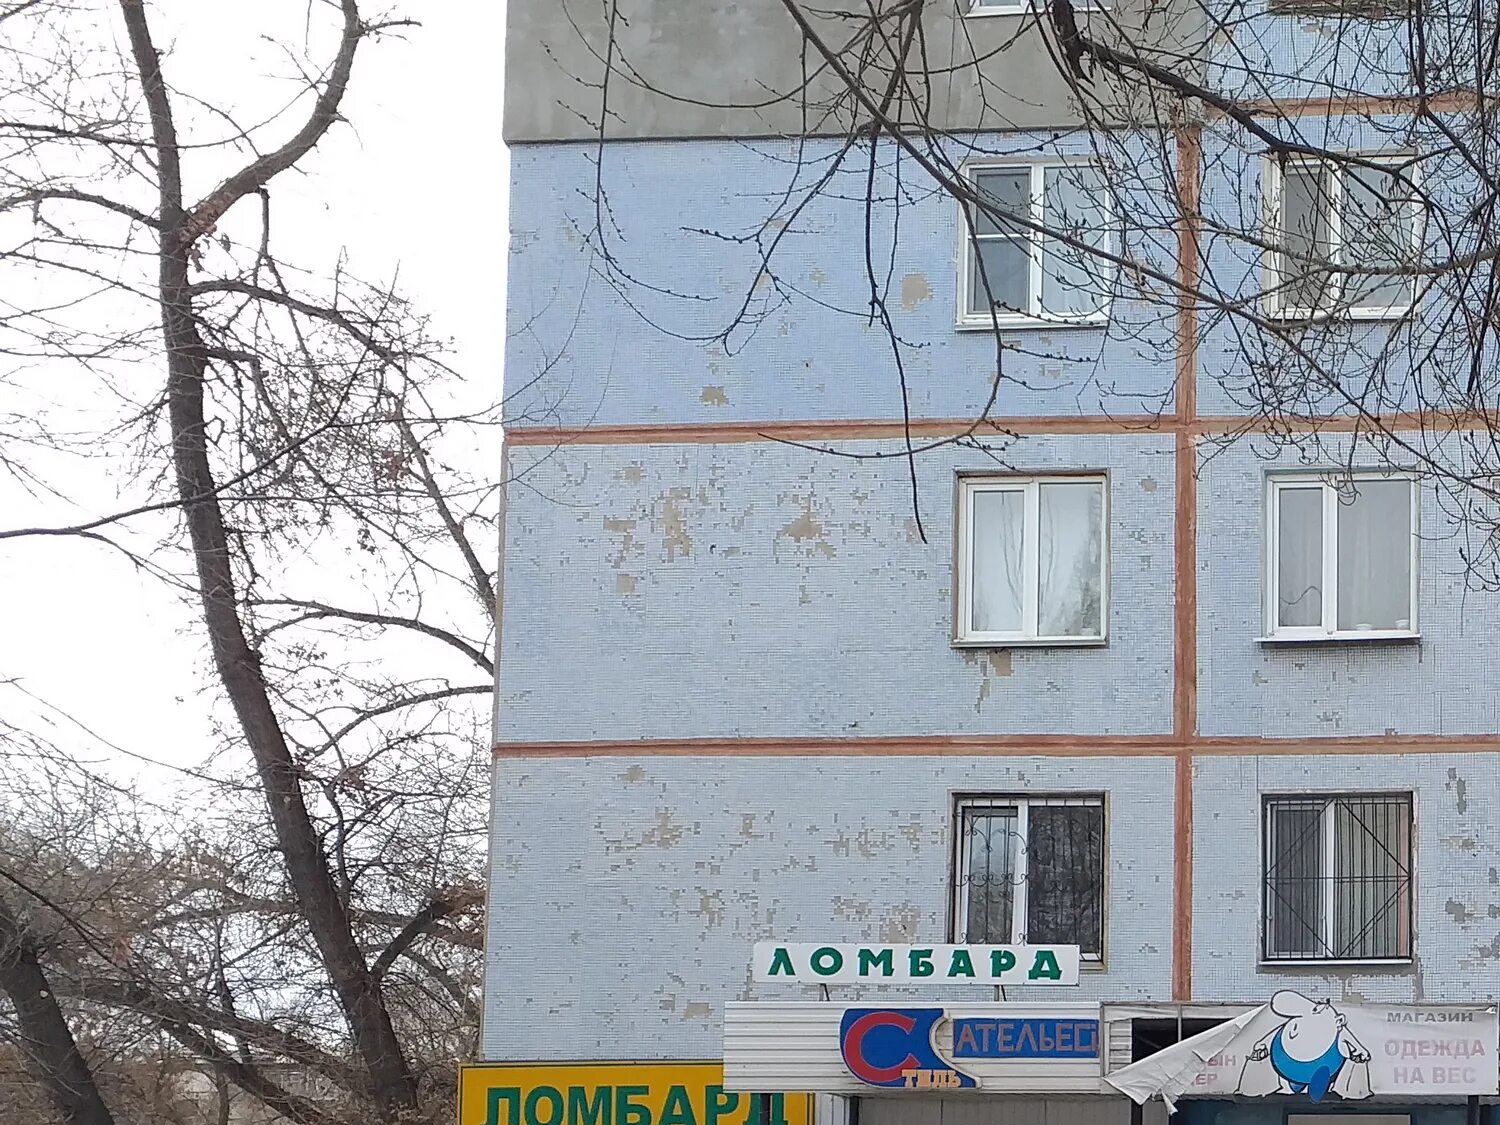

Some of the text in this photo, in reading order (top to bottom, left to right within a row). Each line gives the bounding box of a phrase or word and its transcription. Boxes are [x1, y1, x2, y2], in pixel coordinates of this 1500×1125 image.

[768, 946, 1062, 981] ЛОМБАРД
[1387, 1012, 1473, 1022] МАГАЗИН
[1384, 1040, 1485, 1060] ОДЕЖДА
[1394, 1066, 1476, 1084] НА ВЕС
